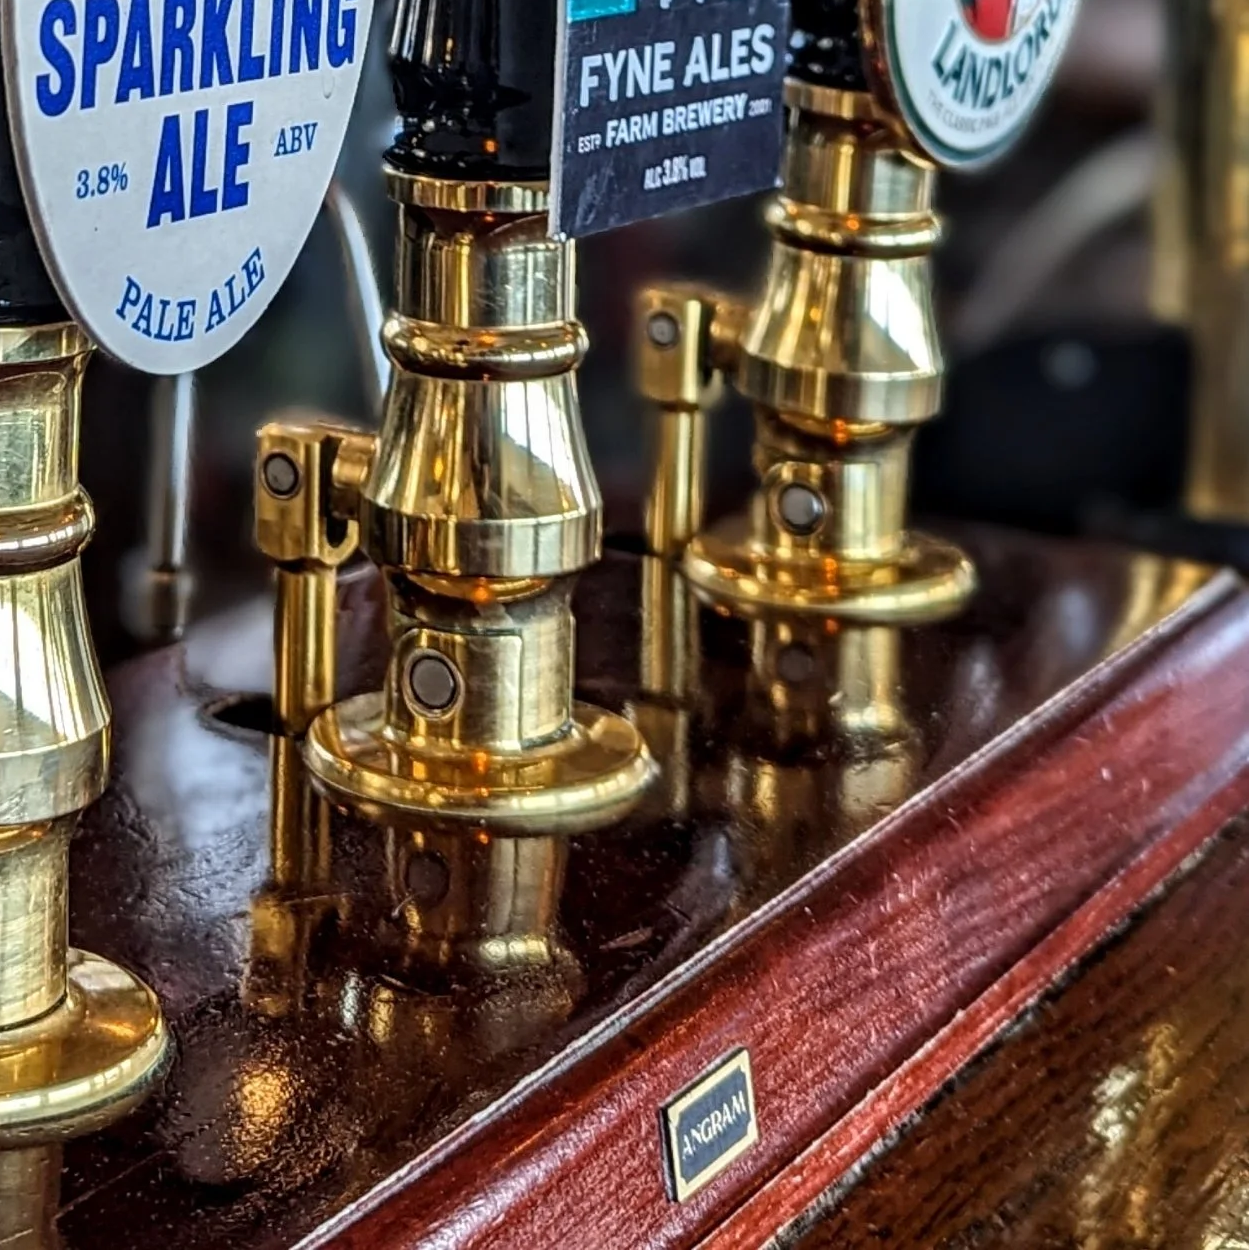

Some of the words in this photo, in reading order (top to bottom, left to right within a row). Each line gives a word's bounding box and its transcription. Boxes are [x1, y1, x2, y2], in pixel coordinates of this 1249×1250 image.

[580, 41, 676, 108] FYNE
[683, 23, 776, 87] ALES
[273, 122, 319, 157] ABV
[605, 111, 659, 148] FARM
[662, 92, 749, 136] BREWERY
[75, 163, 129, 199] 3.8%
[146, 101, 254, 229] ALE
[116, 276, 196, 342] PALE
[204, 247, 266, 333] ALE
[682, 1090, 747, 1161] ANGRAM
